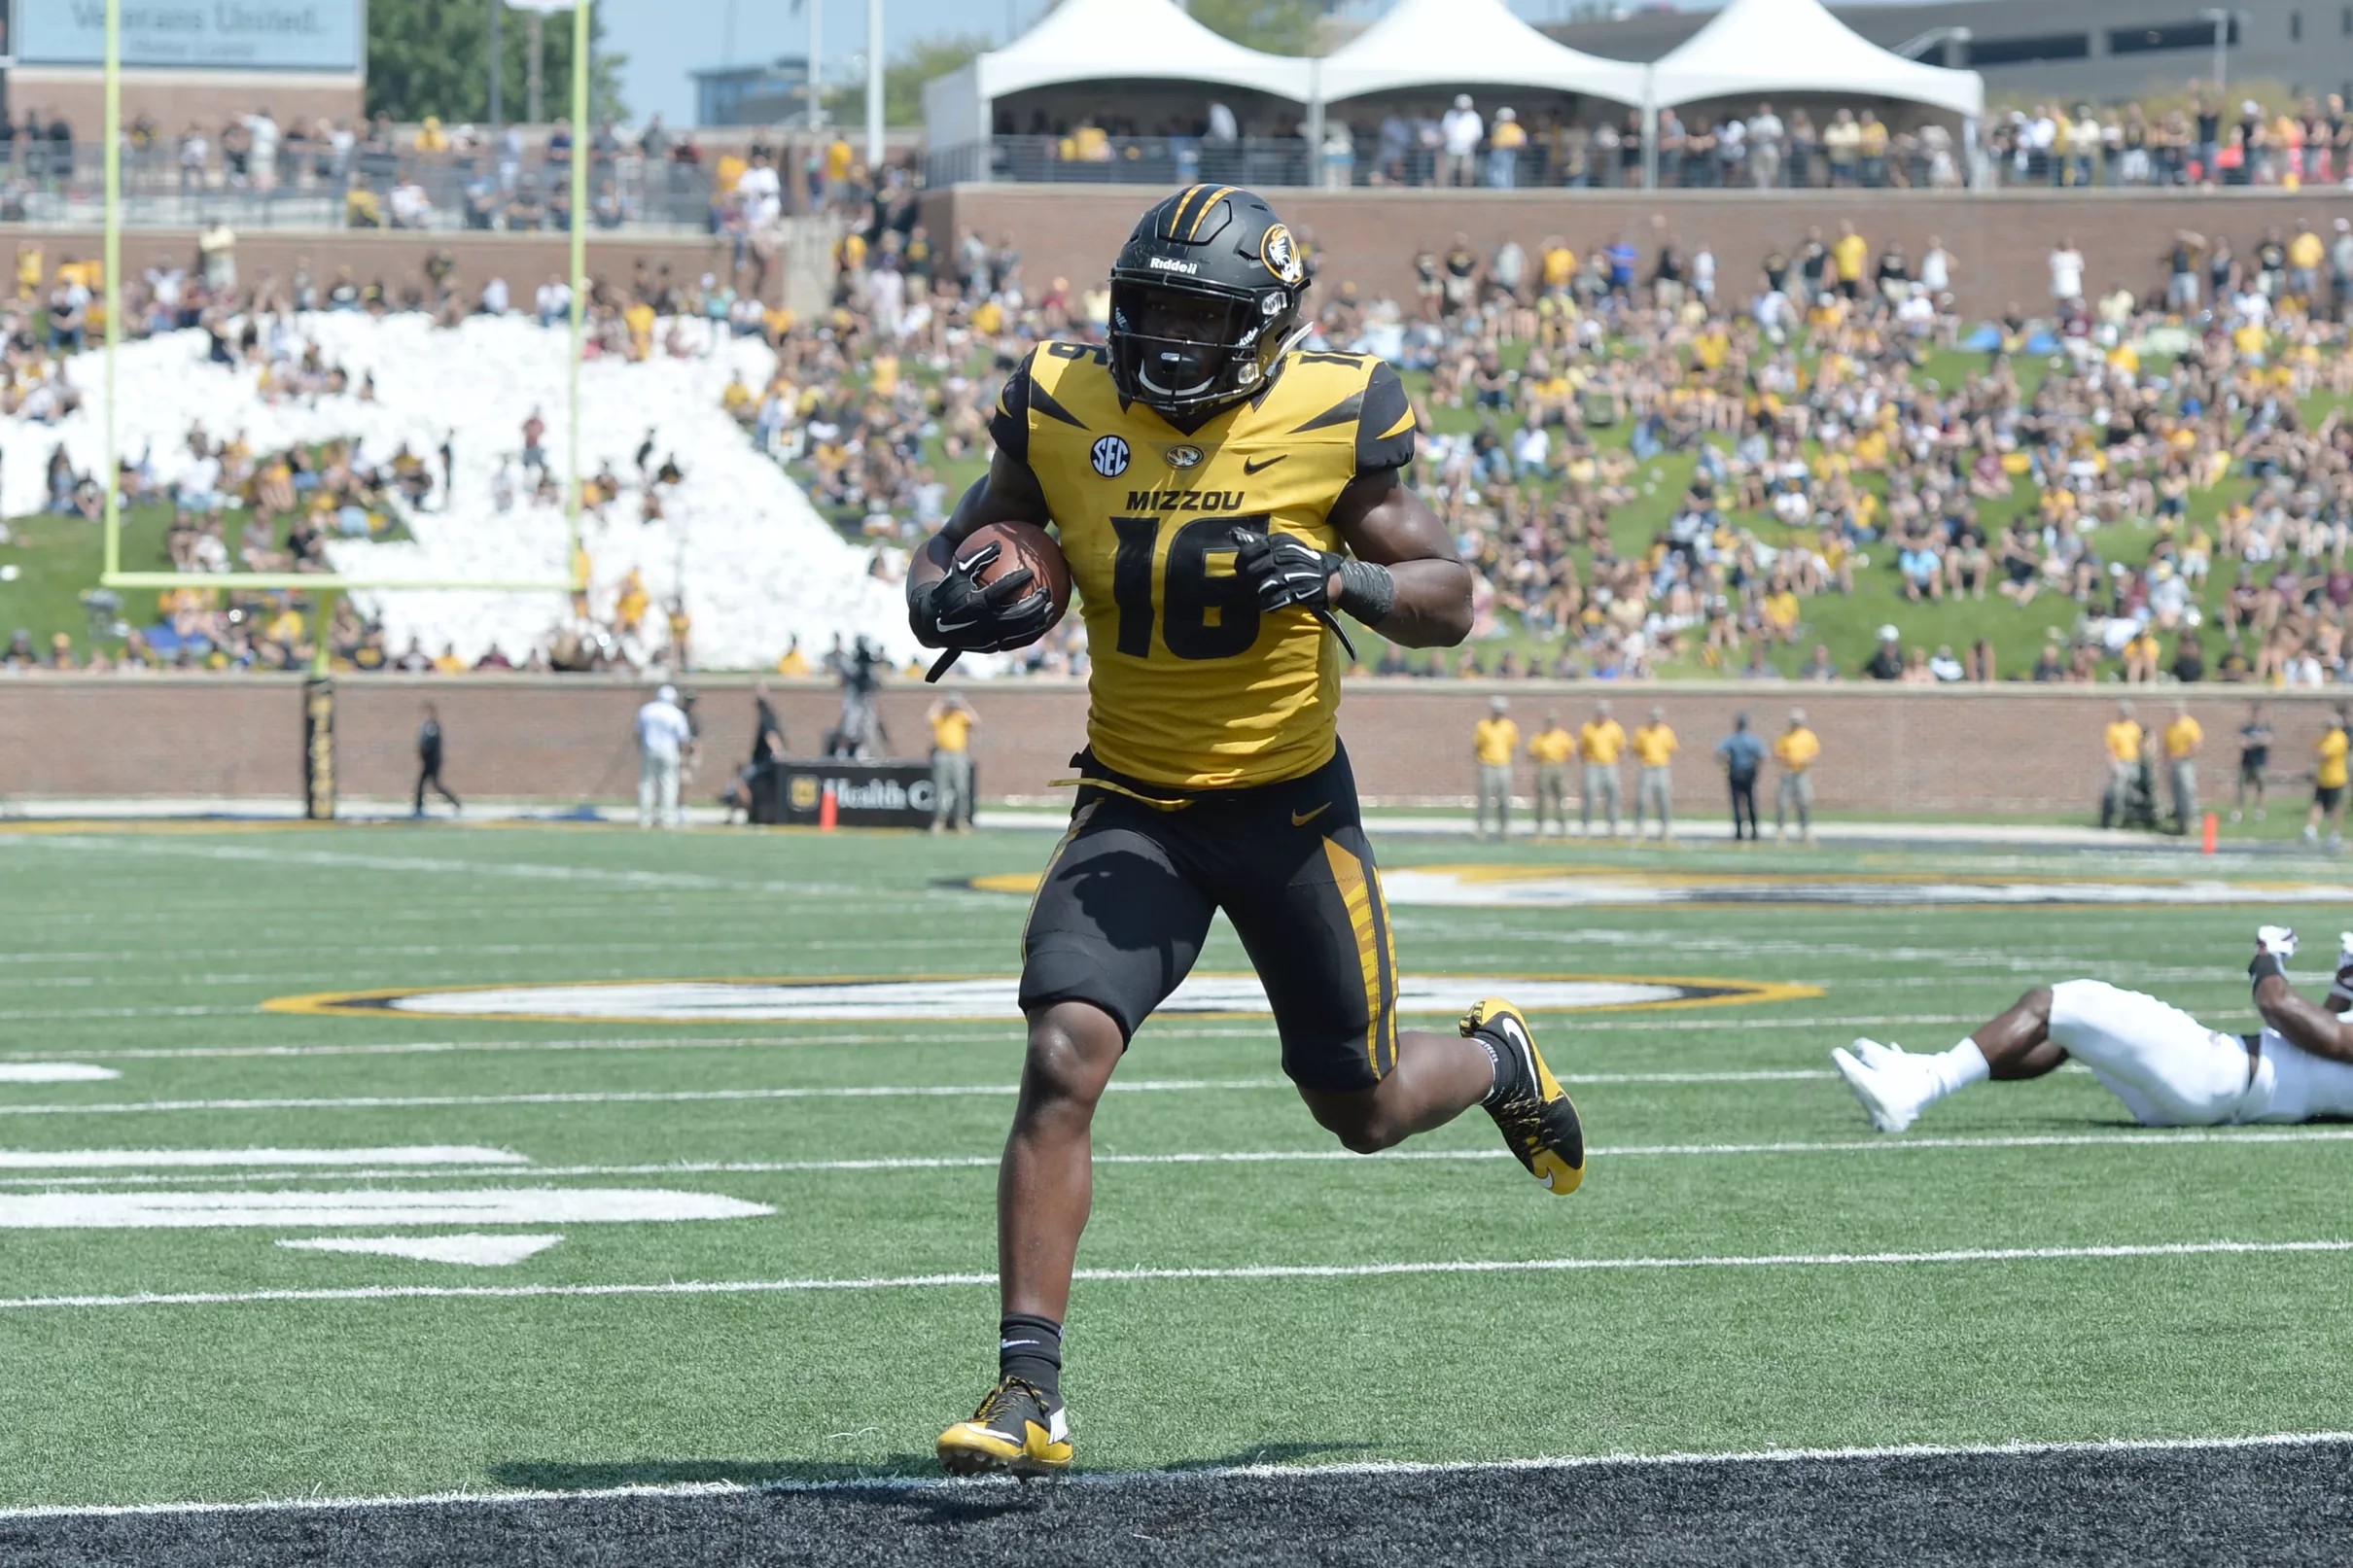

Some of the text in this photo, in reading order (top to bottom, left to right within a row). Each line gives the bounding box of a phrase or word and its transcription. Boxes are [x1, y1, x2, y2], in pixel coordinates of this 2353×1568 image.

[70, 1, 205, 32] Veerans
[1150, 257, 1197, 275] Riddell
[1092, 436, 1129, 476] SEC
[1126, 491, 1245, 510] MIZZOU
[1109, 513, 1271, 660] 16
